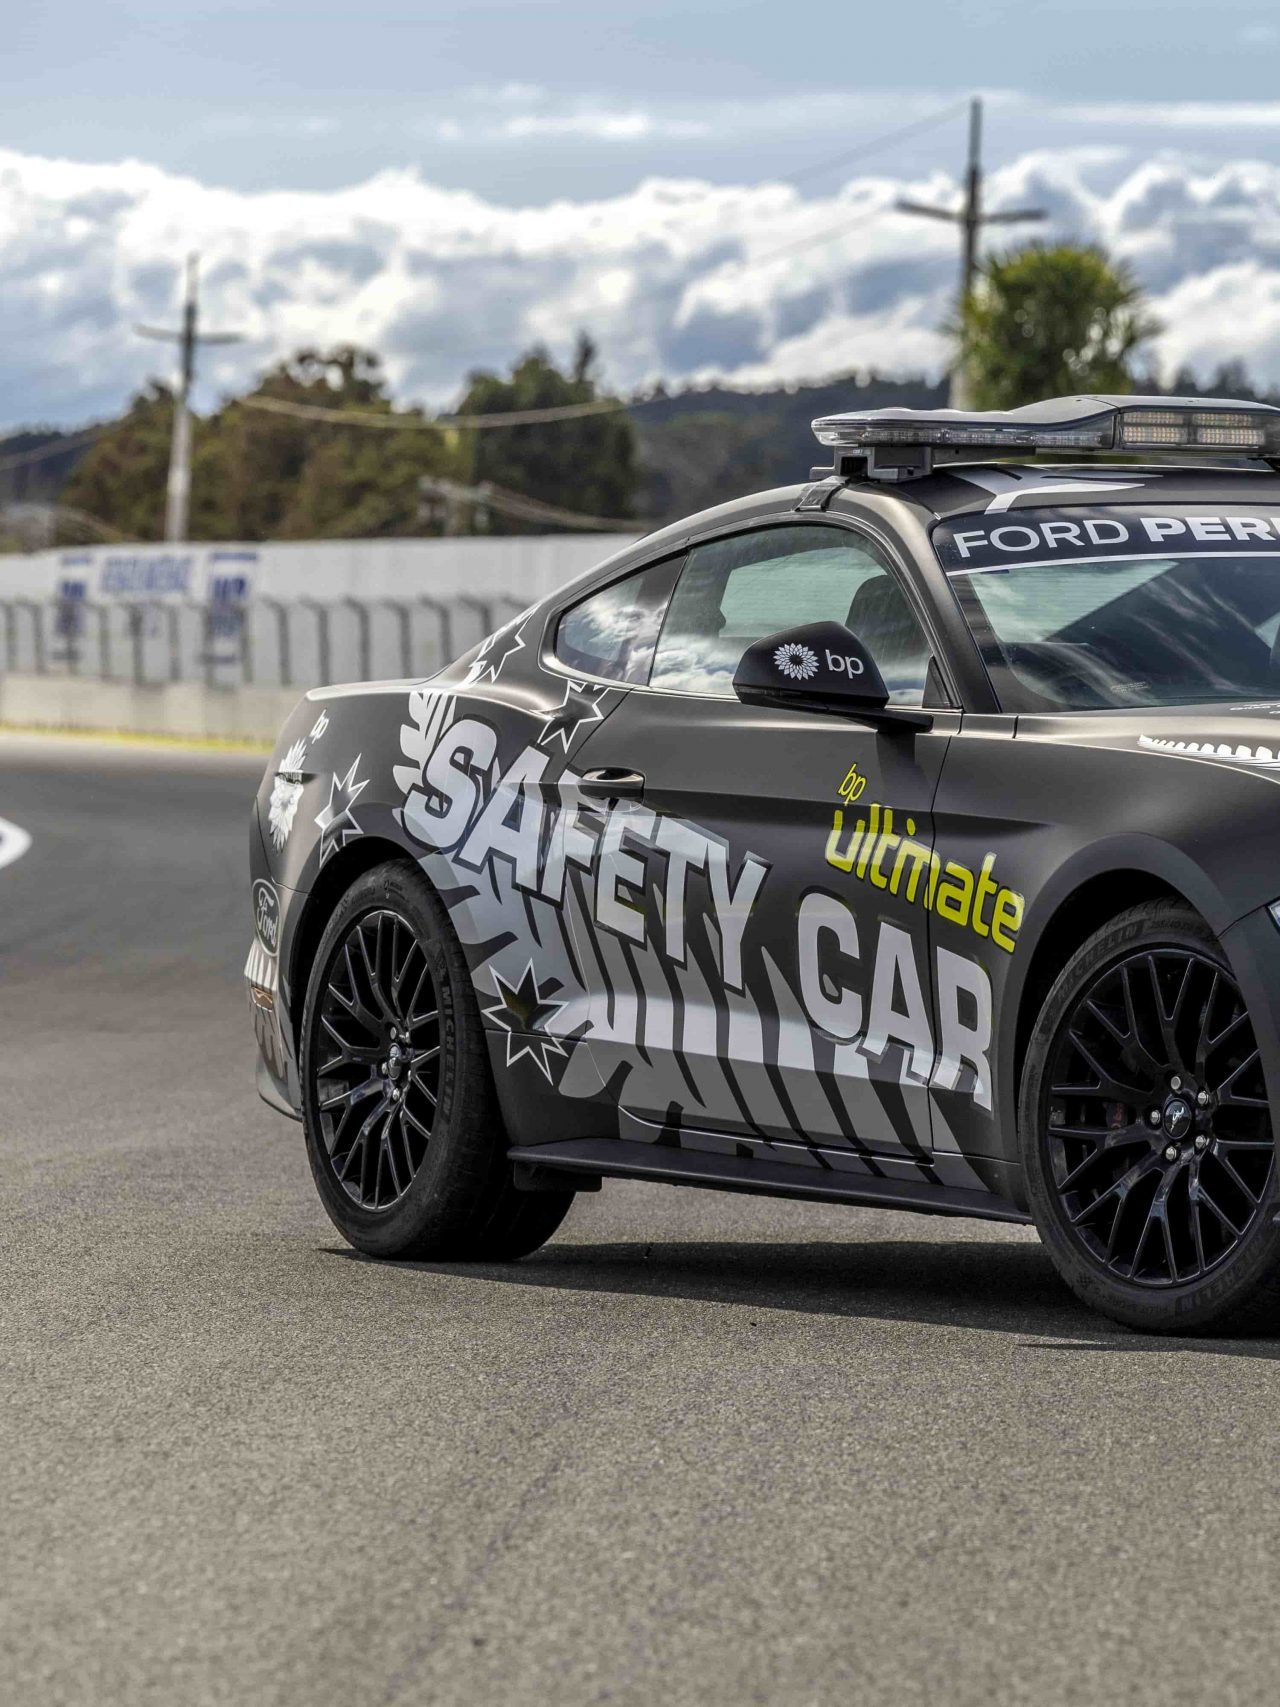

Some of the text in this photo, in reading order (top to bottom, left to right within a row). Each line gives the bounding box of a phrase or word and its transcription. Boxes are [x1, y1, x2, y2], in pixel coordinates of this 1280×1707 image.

[954, 519, 1128, 558] FORD
[825, 649, 864, 676] bp
[309, 708, 329, 743] bp
[837, 763, 867, 803] bp
[825, 804, 1025, 953] ultimate
[256, 887, 279, 947] Ford
[404, 717, 992, 1112] SAFETY CAR
